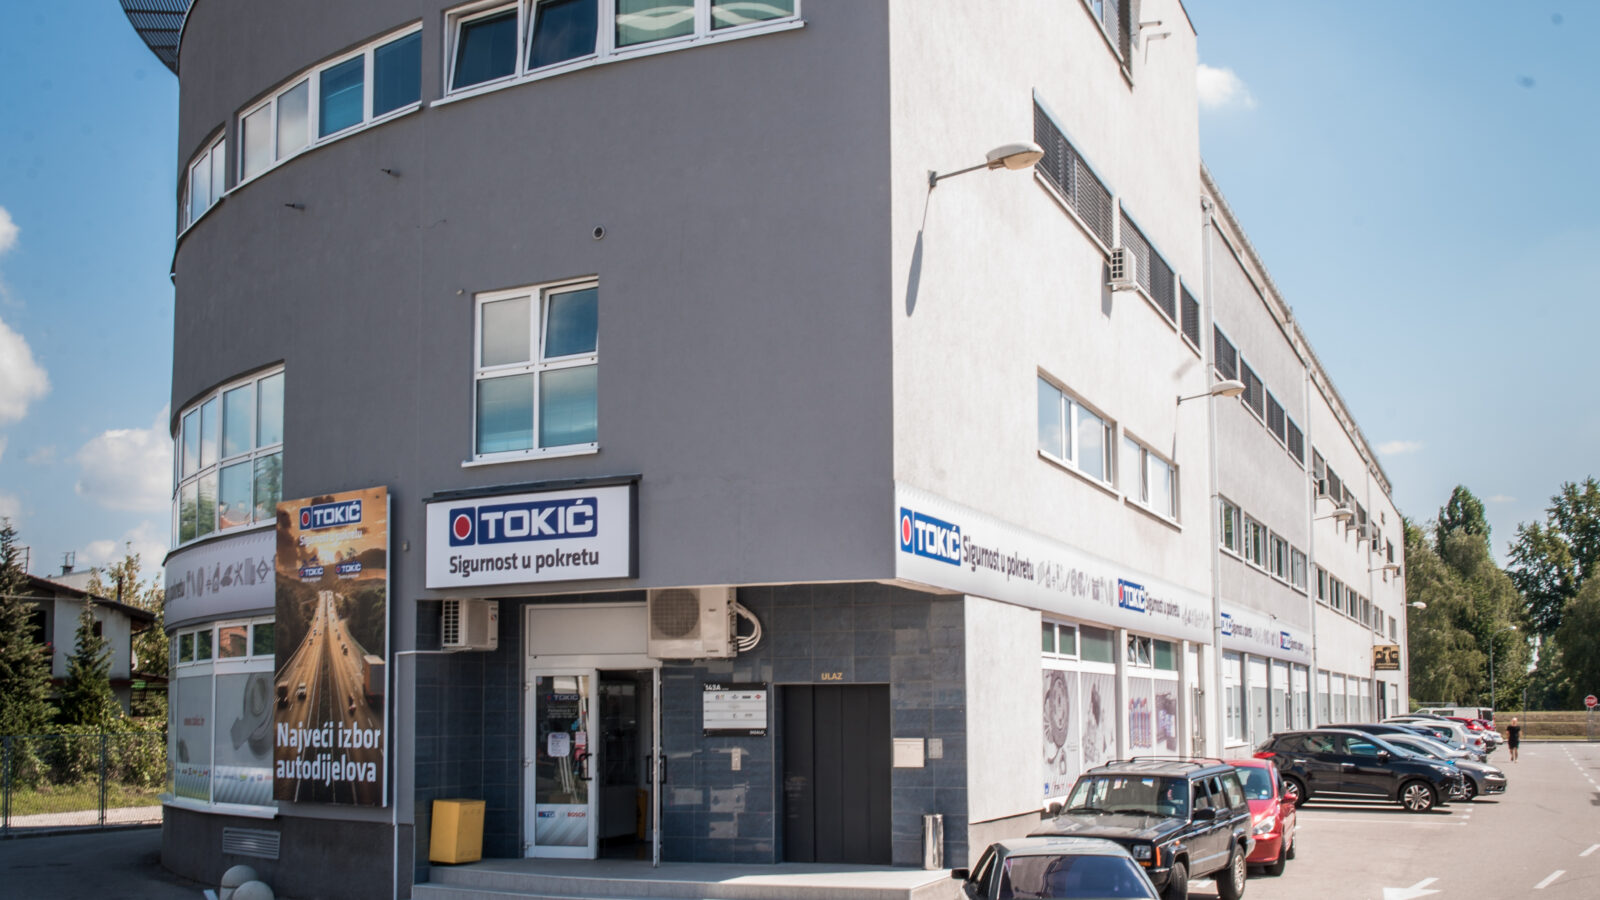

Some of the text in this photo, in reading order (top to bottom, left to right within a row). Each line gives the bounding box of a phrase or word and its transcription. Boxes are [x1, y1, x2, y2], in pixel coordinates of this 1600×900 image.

[314, 501, 361, 525] TOKIĆ
[480, 499, 594, 540] TOKIĆ
[449, 548, 600, 578] Sigurnost u pokretu
[915, 520, 1034, 581] TOKIĆ Sigurnost u pokretu
[821, 672, 843, 681] ULAZ
[277, 721, 381, 753] Najveći izbor
[276, 753, 377, 787] autodijelova
